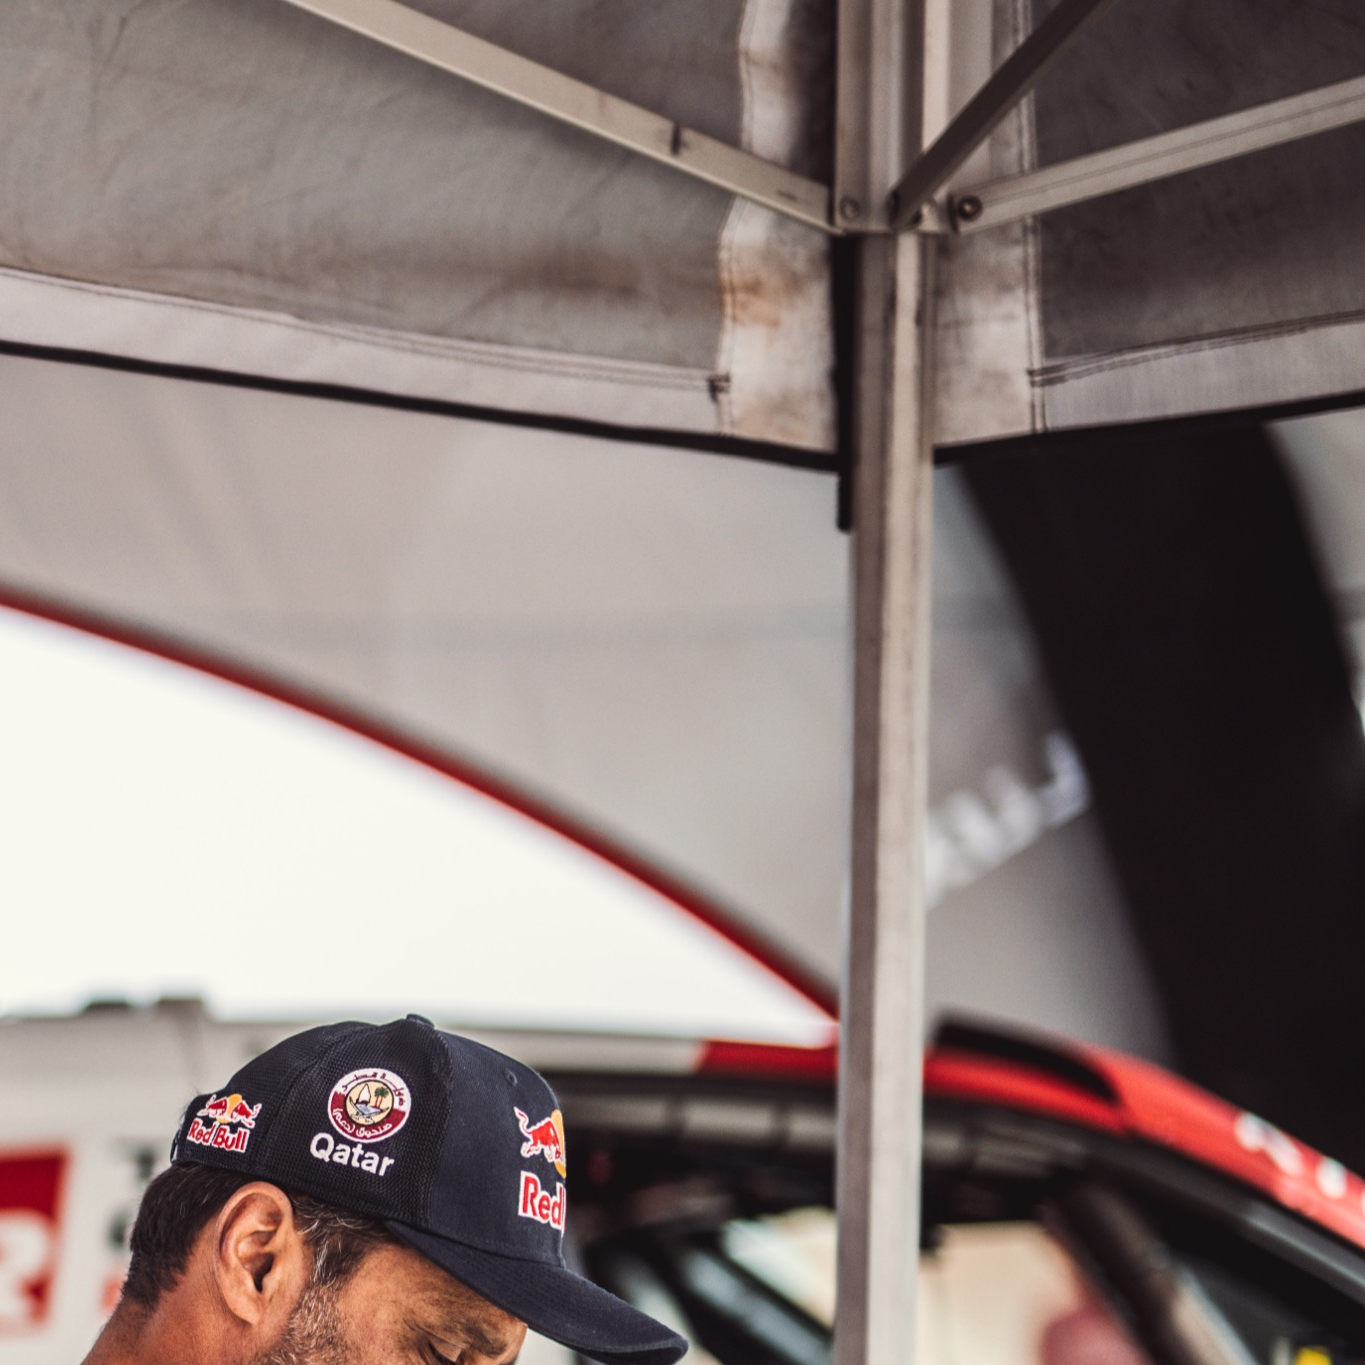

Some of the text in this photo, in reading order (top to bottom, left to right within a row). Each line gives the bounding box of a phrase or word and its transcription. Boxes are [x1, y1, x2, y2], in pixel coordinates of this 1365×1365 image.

[187, 1117, 251, 1154] Red Bull
[310, 1131, 395, 1178] Qatar
[518, 1170, 564, 1231] Red
